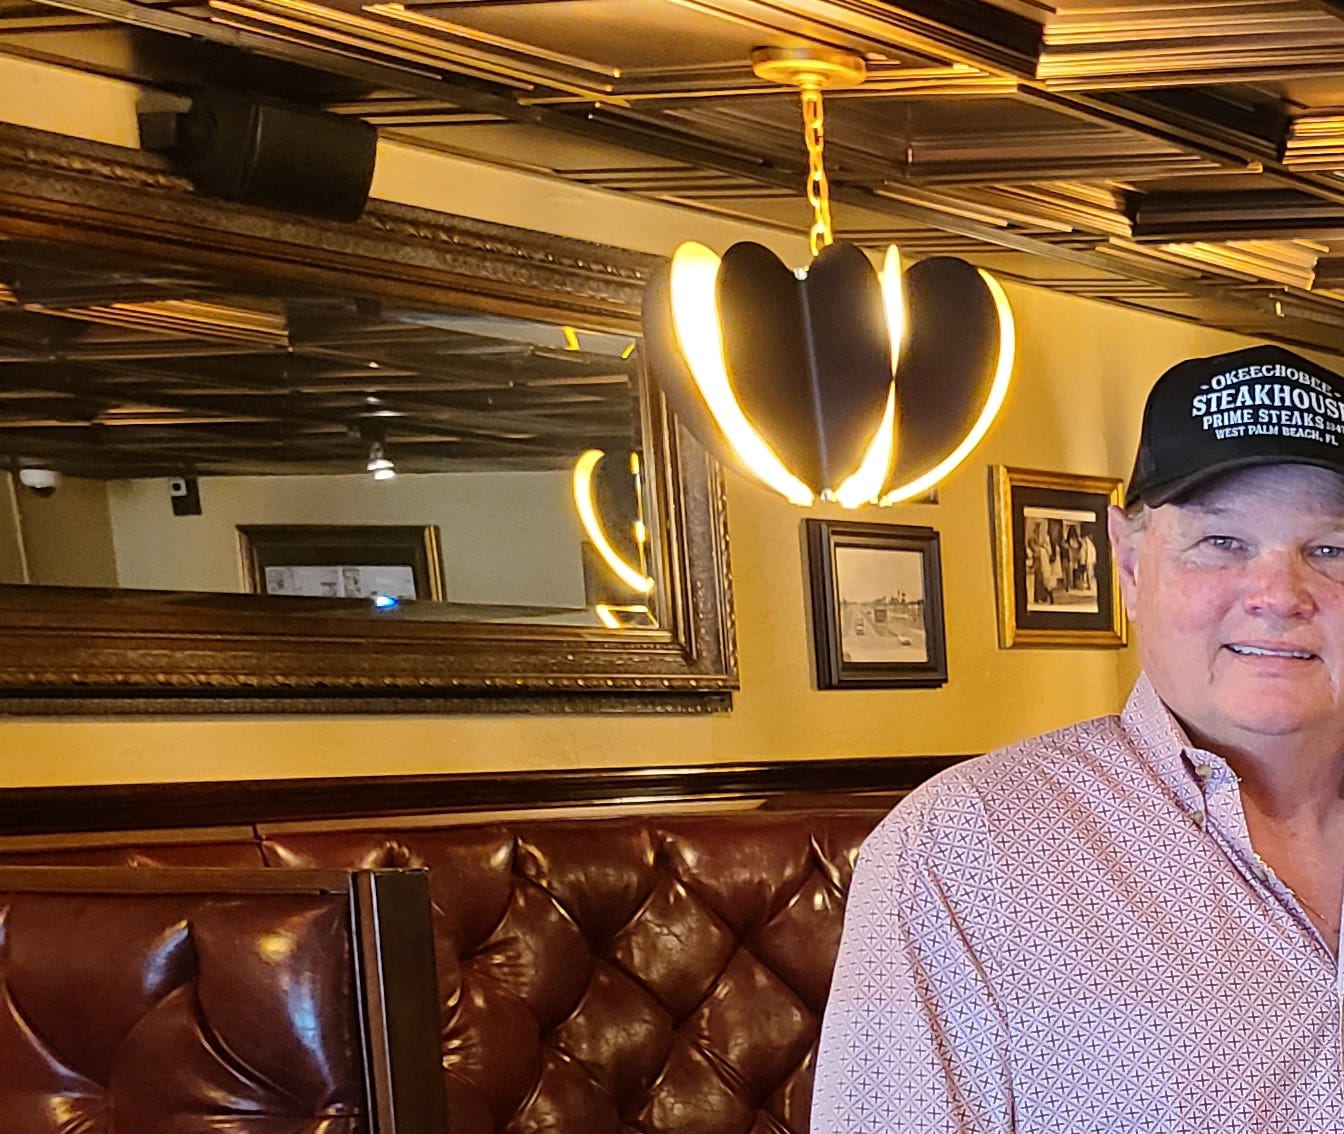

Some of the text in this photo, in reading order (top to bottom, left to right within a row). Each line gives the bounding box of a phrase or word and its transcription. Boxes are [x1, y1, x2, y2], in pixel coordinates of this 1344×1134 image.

[1211, 364, 1333, 397] OKEECHOBEE
[1203, 409, 1254, 430] PRIME
[1258, 409, 1325, 429] STEAKS
[1215, 424, 1340, 446] WEST PALM BEACH, FL
